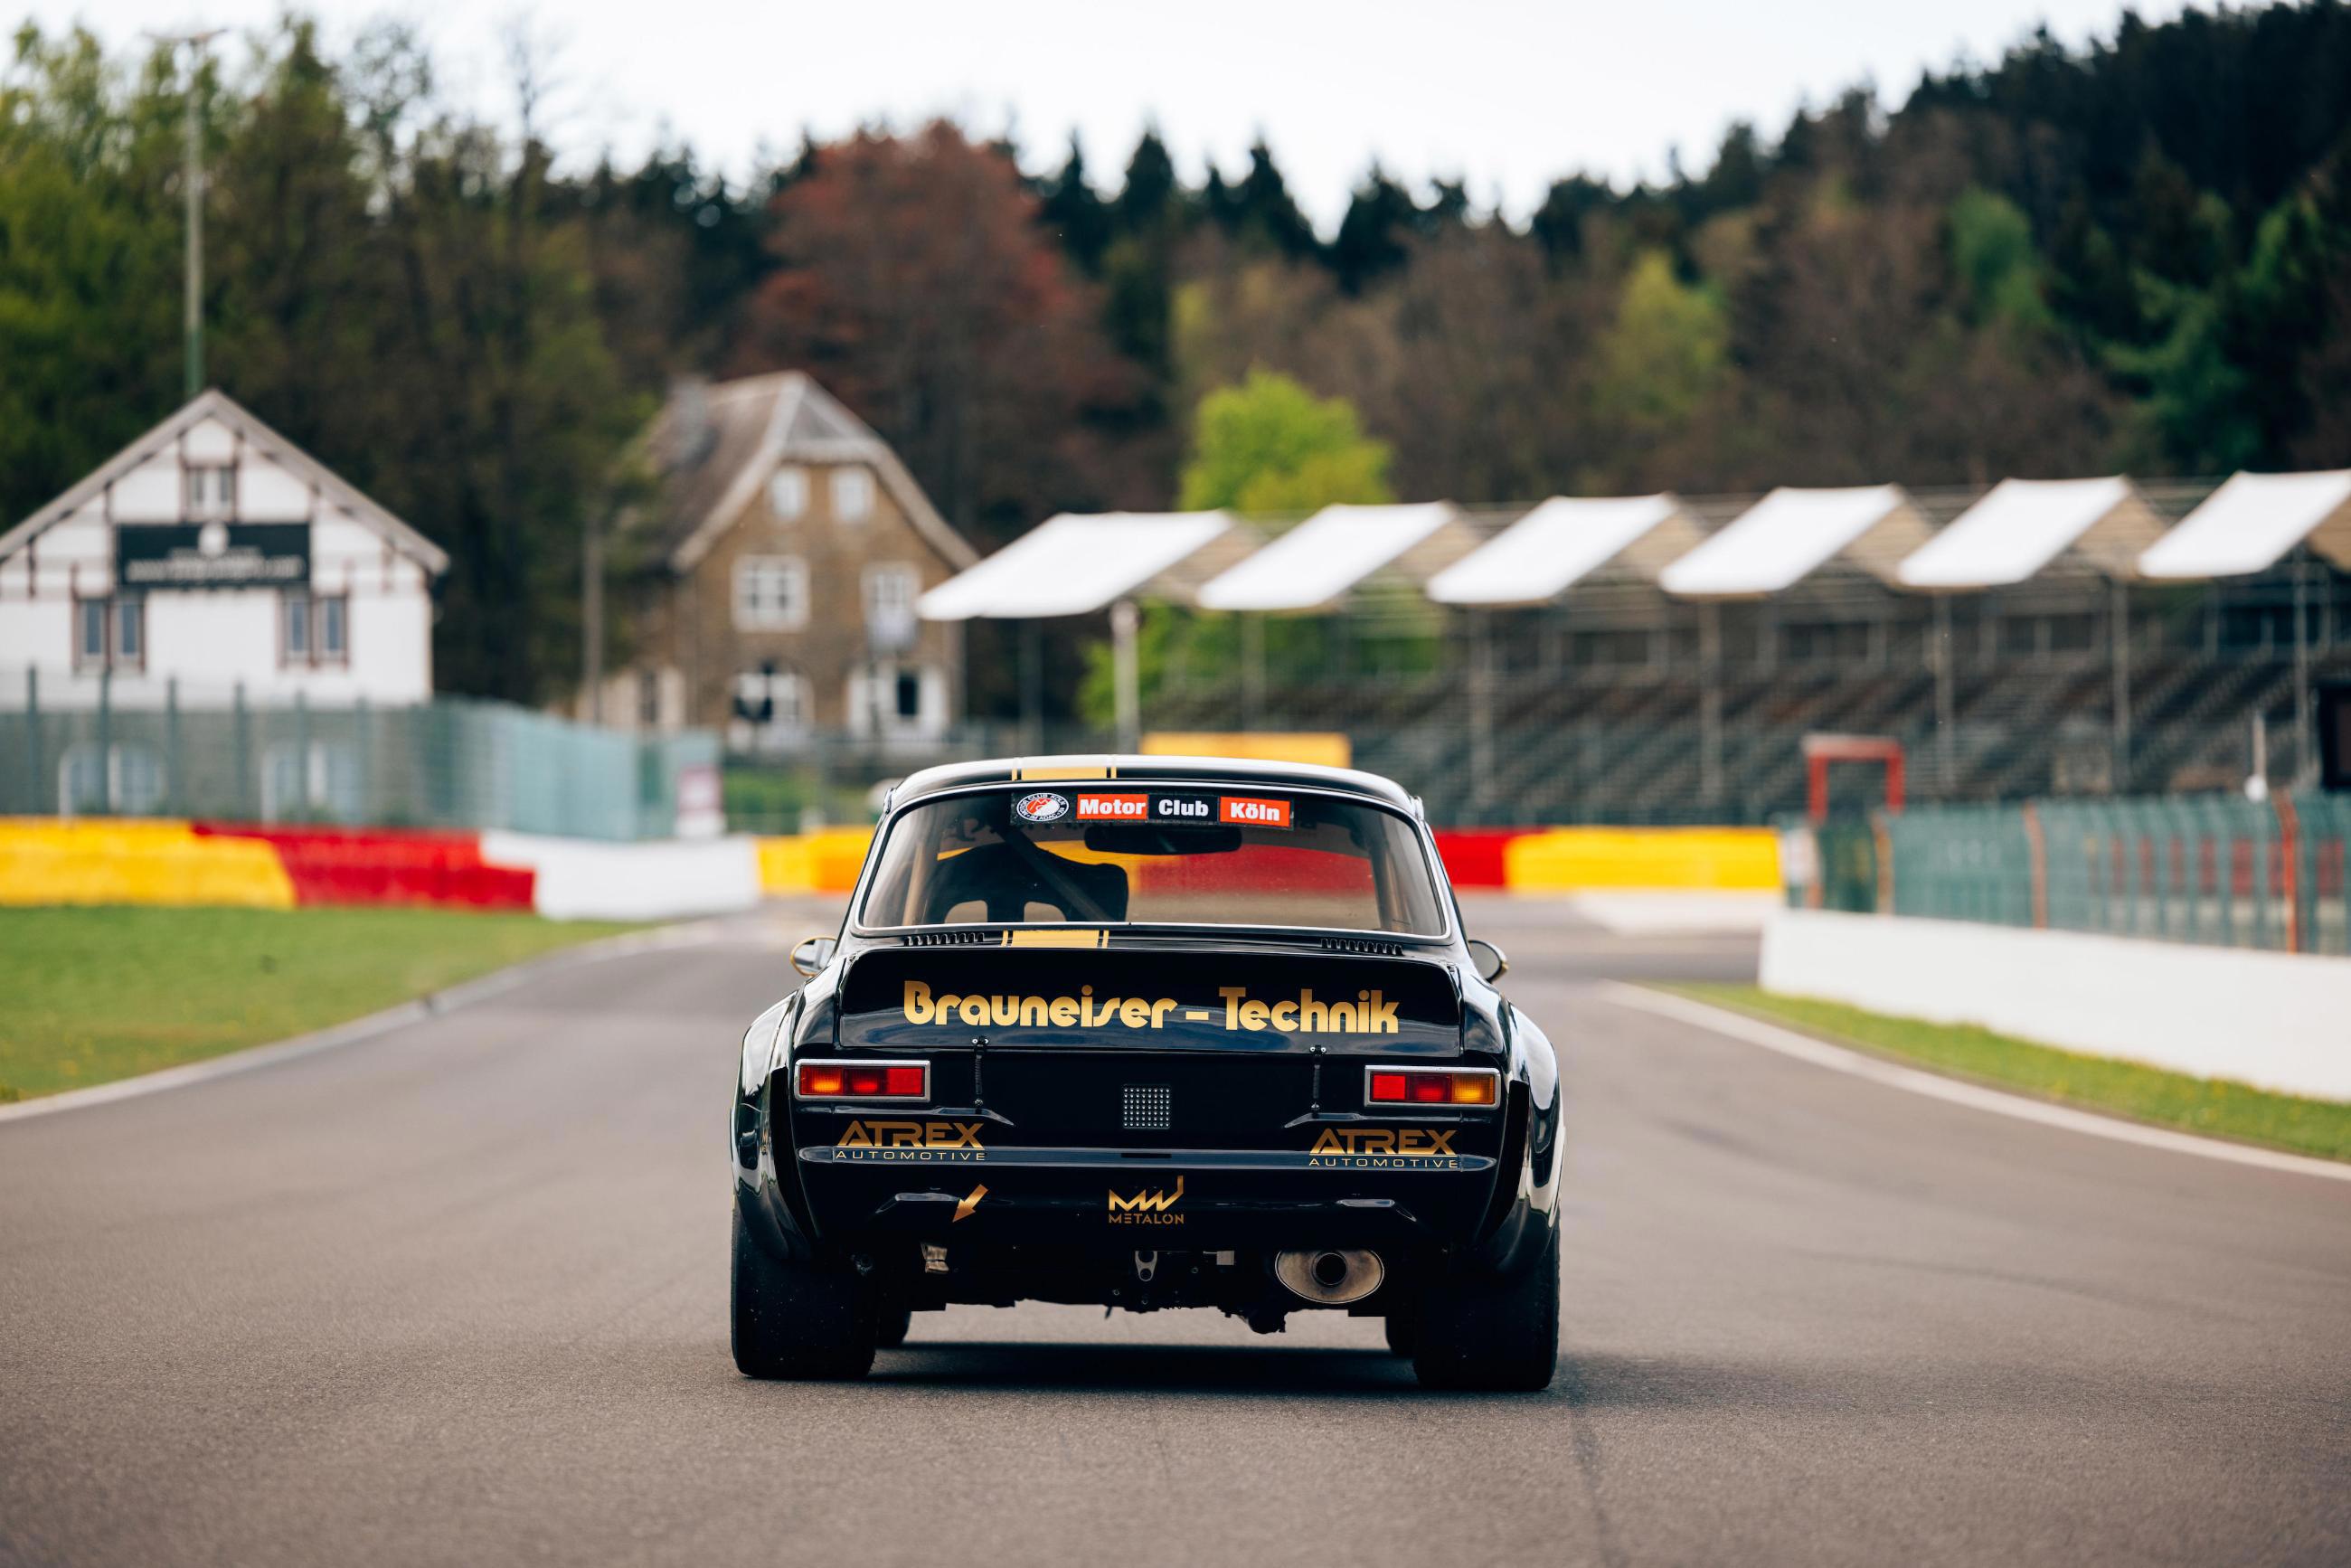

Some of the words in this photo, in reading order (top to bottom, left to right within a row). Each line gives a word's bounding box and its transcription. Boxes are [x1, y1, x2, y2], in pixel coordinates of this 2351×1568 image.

[1079, 798, 1147, 815] Motor
[1158, 798, 1209, 817] Club
[1230, 802, 1280, 821] Köln
[903, 980, 1178, 1028] Brauneiser
[1219, 987, 1399, 1034] Technik
[836, 1119, 985, 1149] ATREX
[1309, 1128, 1458, 1156] ATREX
[835, 1150, 986, 1161] AUTOMOTIVE
[1308, 1157, 1459, 1168] AUTOMOTIVE
[1108, 1213, 1185, 1224] METALON
